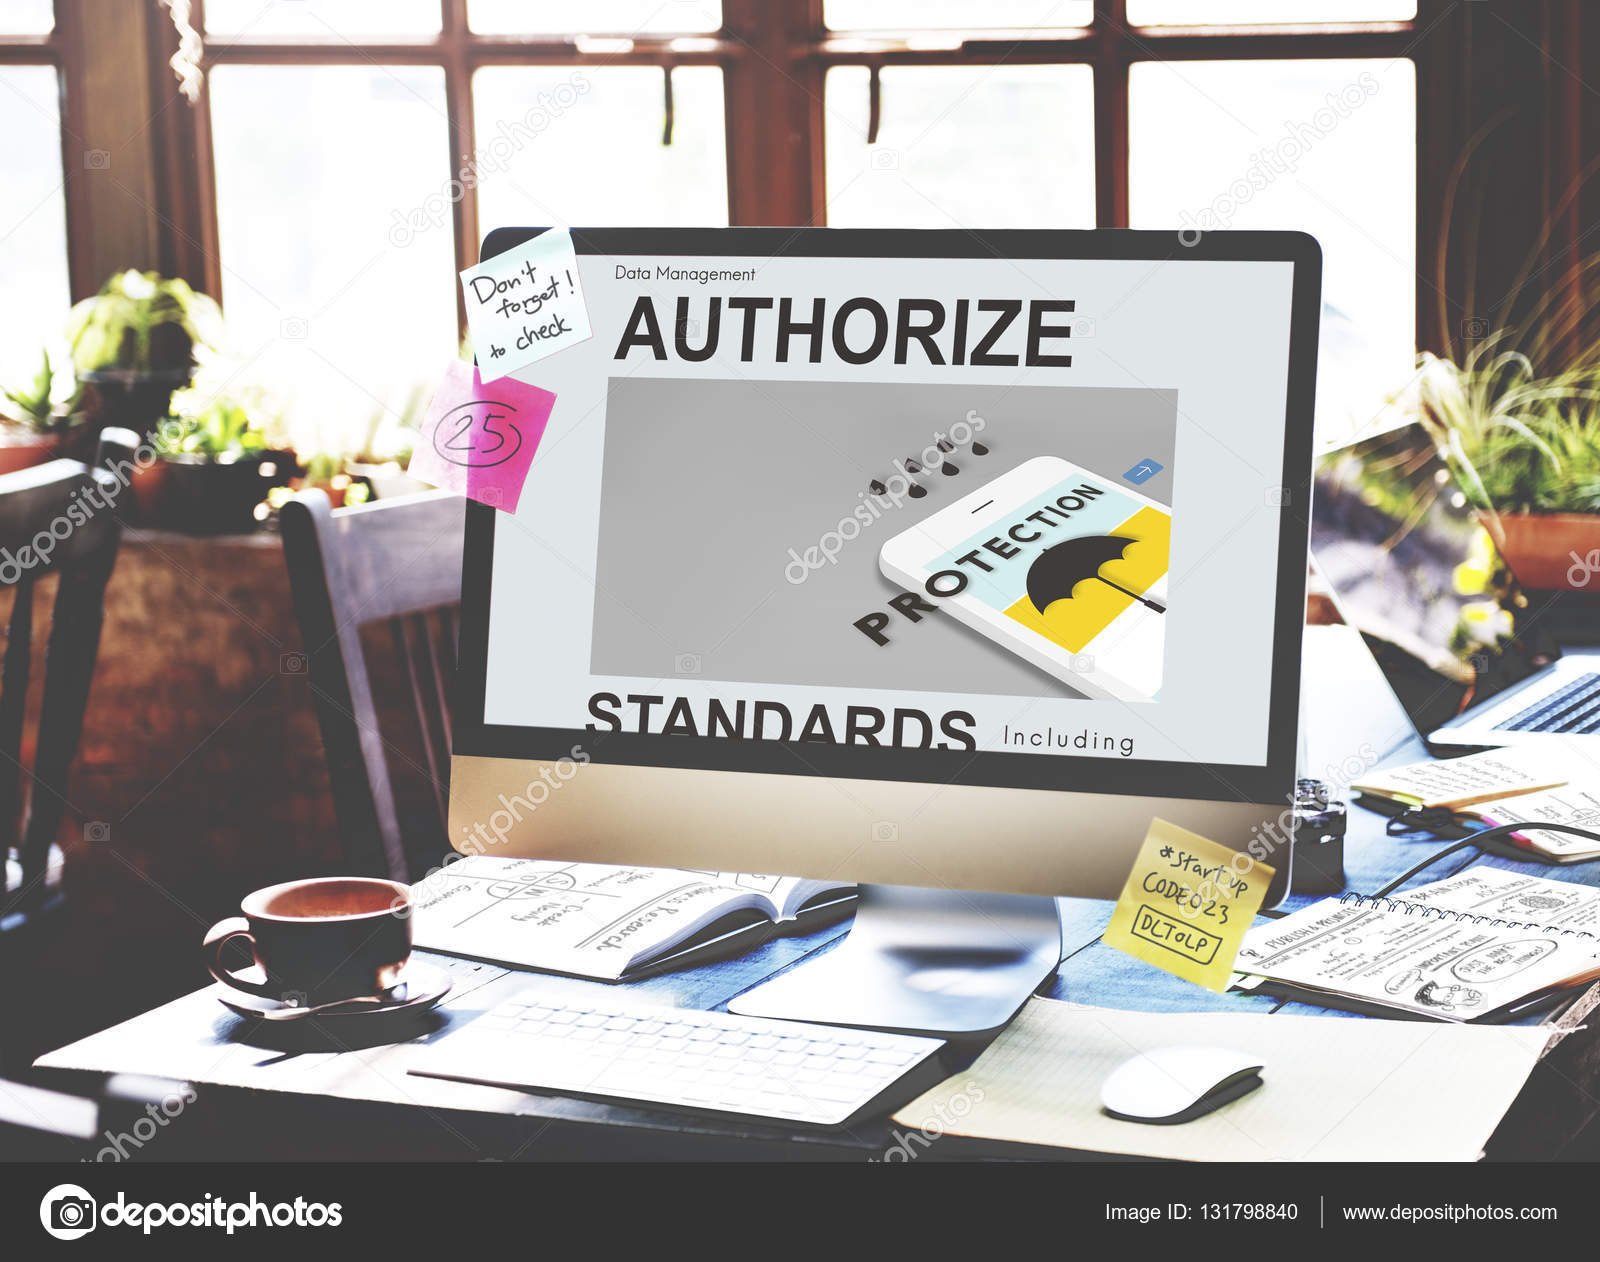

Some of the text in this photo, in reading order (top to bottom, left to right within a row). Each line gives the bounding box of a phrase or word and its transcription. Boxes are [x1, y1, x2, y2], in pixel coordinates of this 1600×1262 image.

[469, 260, 538, 304] Don't
[615, 264, 756, 285] Data Management
[490, 314, 572, 359] to check
[614, 296, 1076, 368] AUTHORIZE
[445, 413, 506, 454] 25
[852, 484, 1105, 648] PROTECTION
[585, 691, 1136, 757] STANDARDS Including
